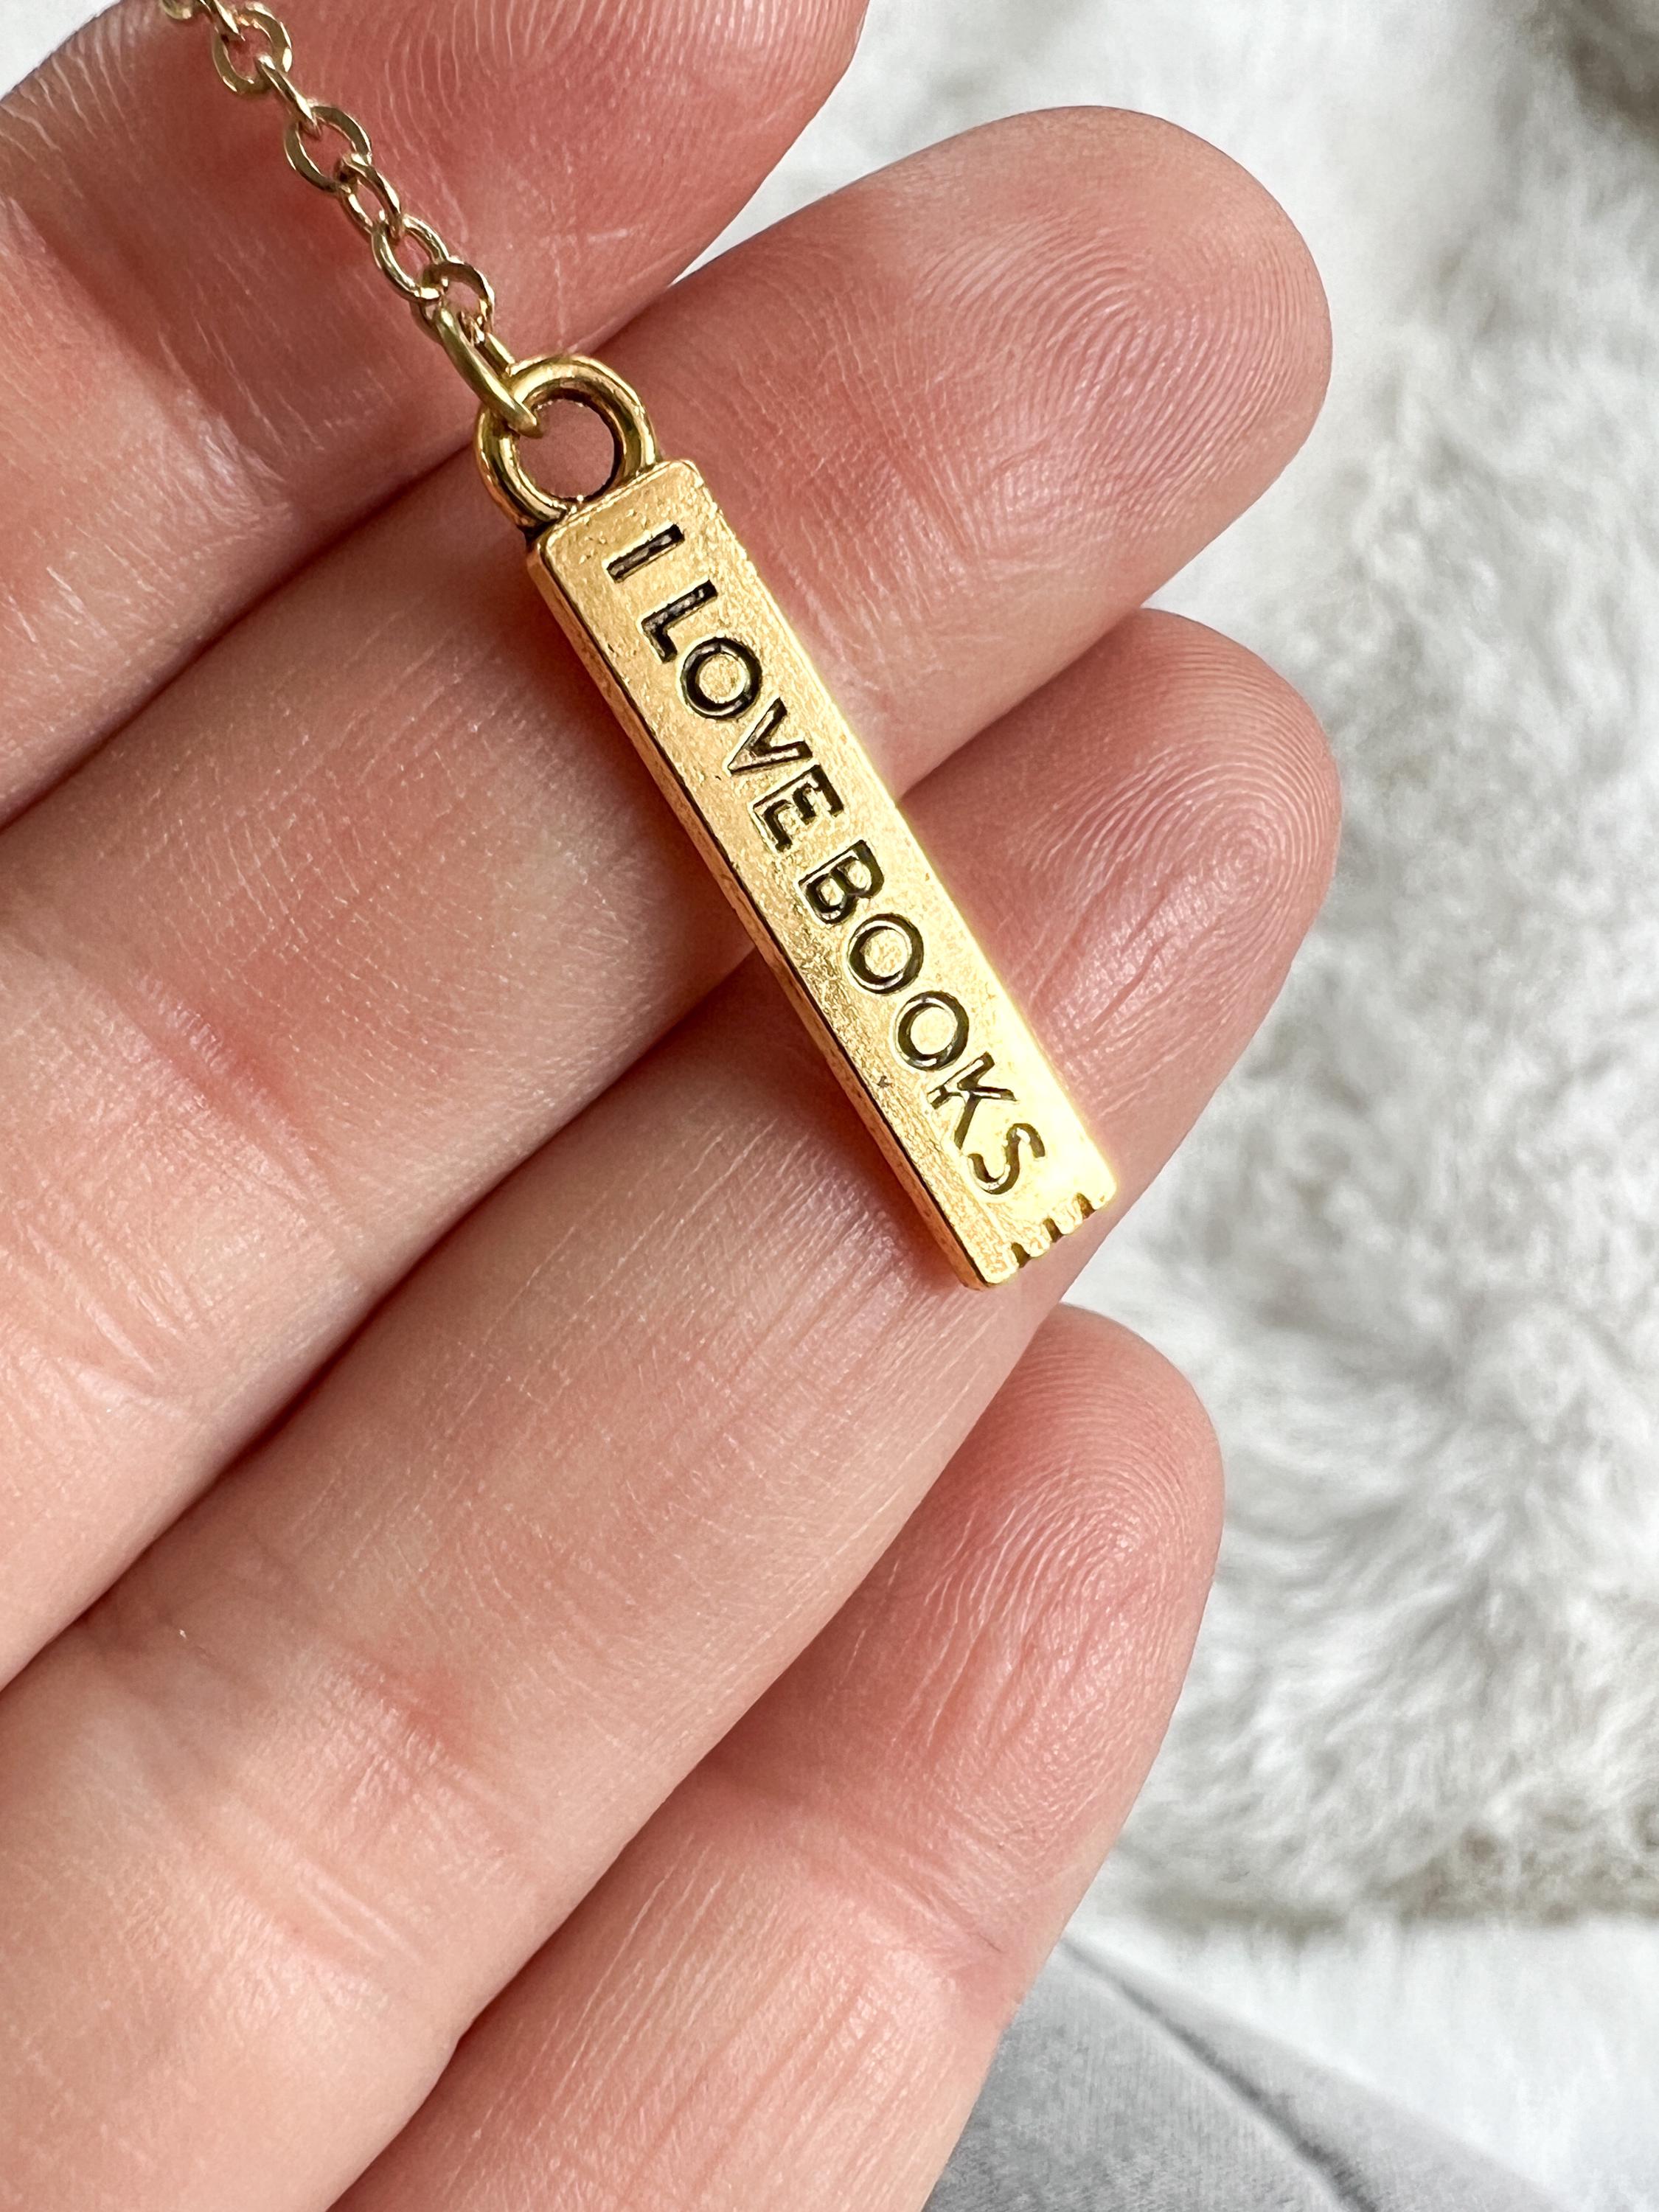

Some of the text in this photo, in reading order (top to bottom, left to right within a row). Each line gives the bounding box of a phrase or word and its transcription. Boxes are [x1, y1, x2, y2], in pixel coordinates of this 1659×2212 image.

[606, 523, 1046, 1195] I LOVE BOOKS
